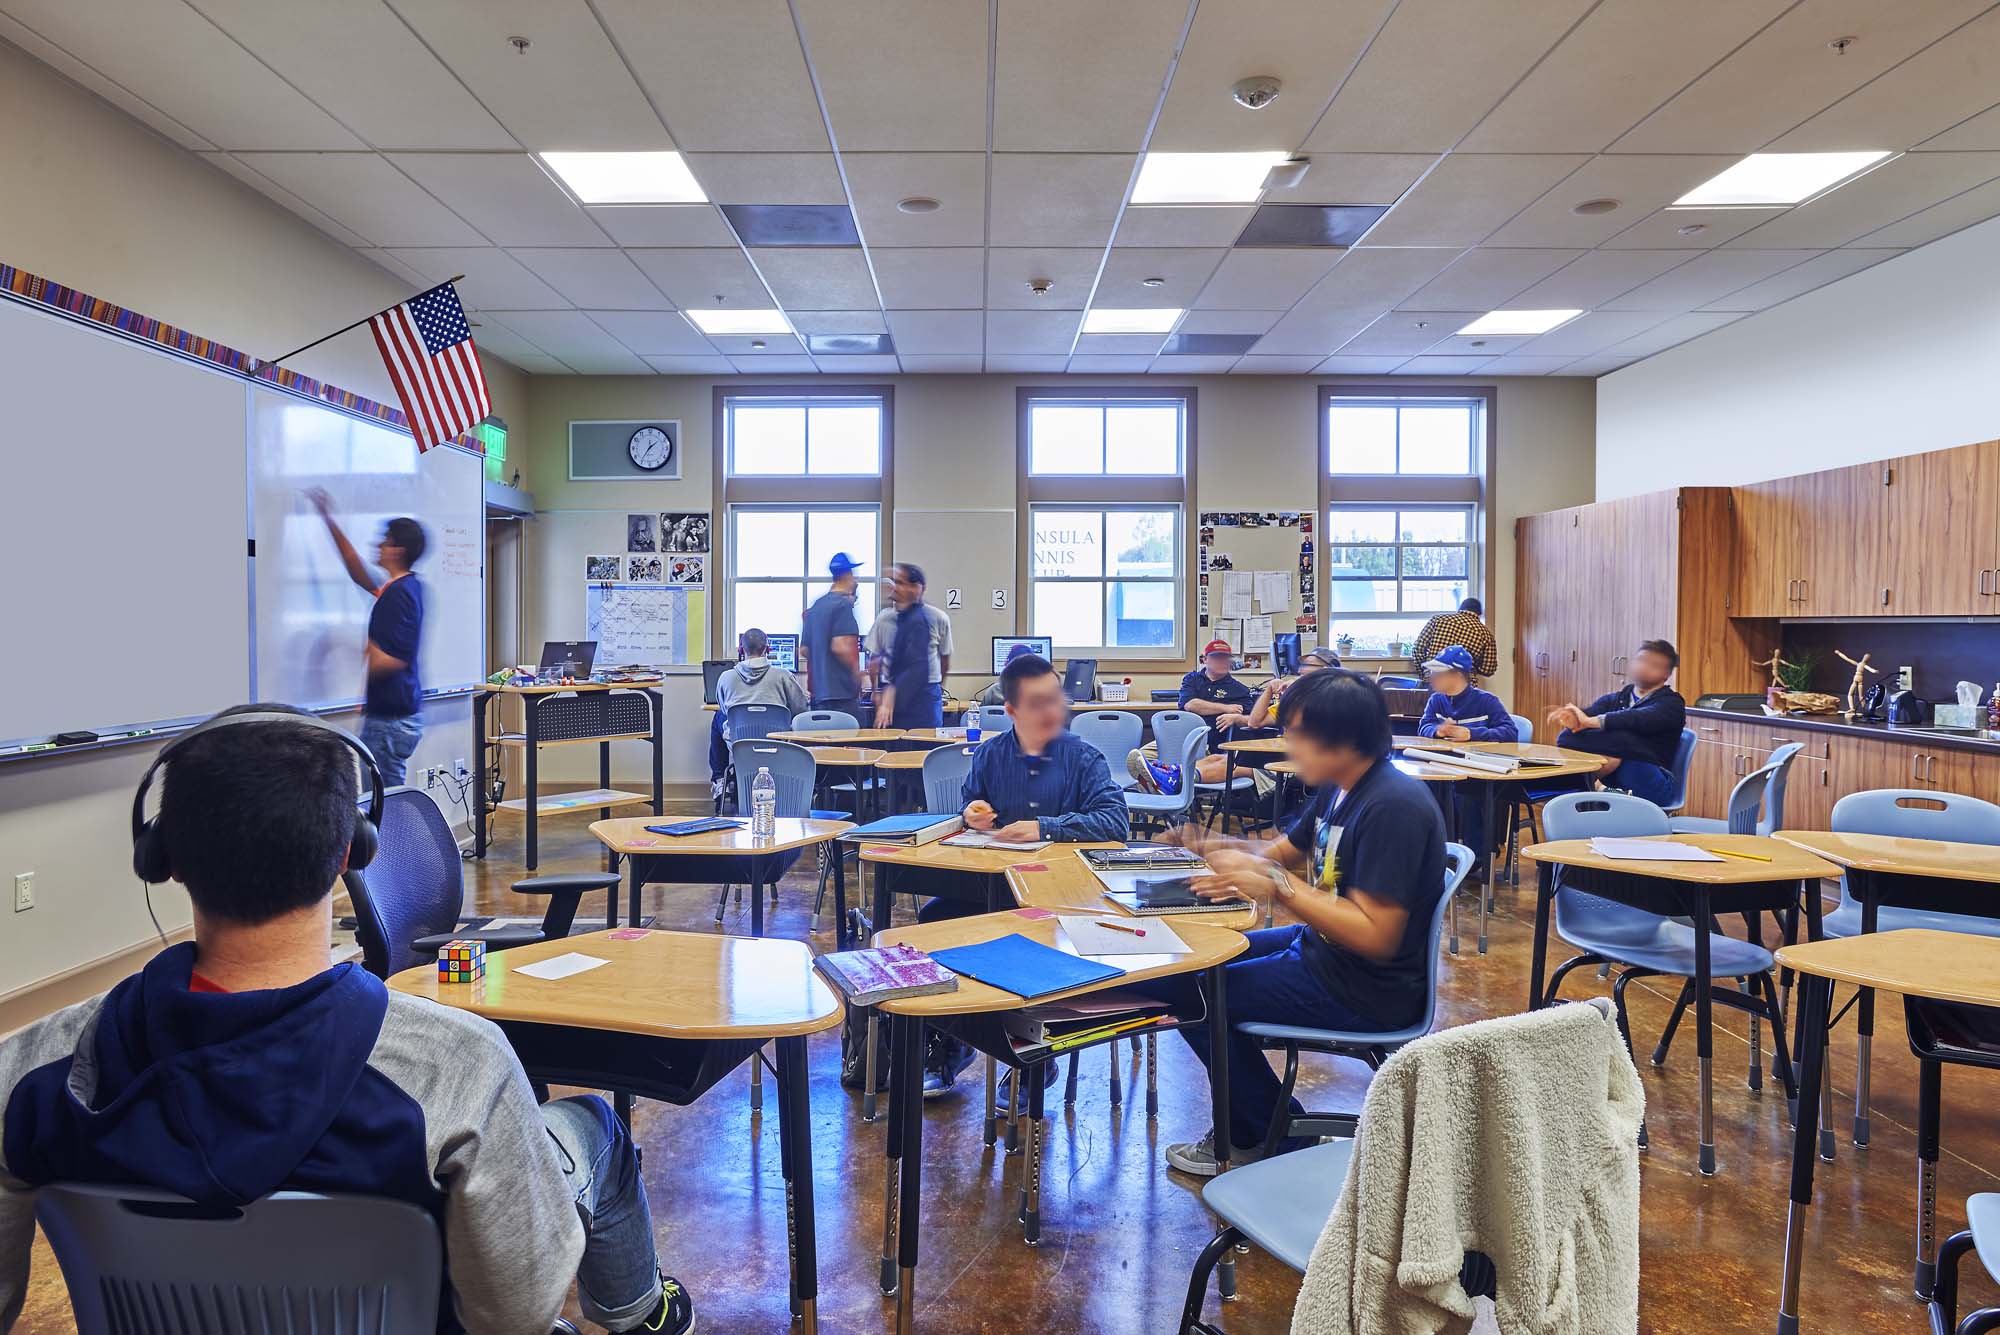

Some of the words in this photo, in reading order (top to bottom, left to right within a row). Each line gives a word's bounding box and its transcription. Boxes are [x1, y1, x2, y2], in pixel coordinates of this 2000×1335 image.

[1036, 530, 1095, 544] NSULA
[948, 589, 961, 606] 2
[994, 590, 1006, 607] 3
